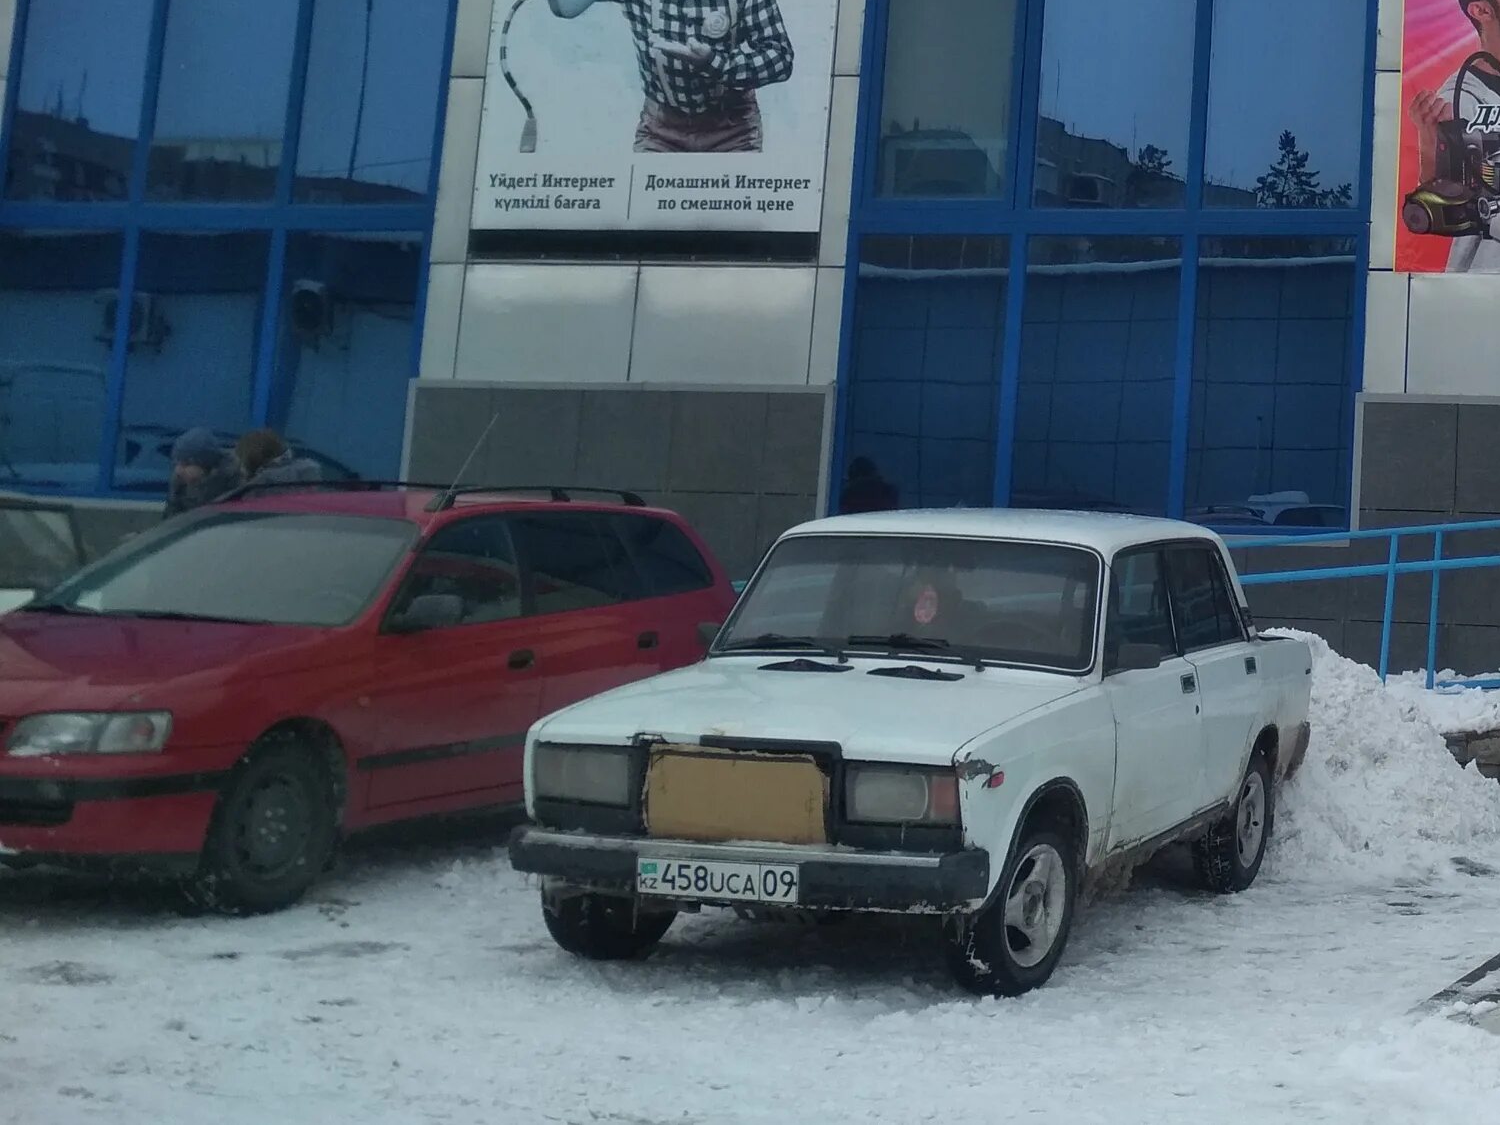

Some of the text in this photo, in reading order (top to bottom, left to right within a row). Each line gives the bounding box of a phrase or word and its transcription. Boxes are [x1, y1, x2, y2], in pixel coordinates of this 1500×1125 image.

[489, 173, 615, 192] Үйдегі Интернет
[645, 174, 811, 193] Домашний Интернет
[494, 195, 602, 213] күлкілі бағаға
[657, 195, 795, 214] по смешной цене
[639, 863, 797, 898] KZ 458UCA 09
